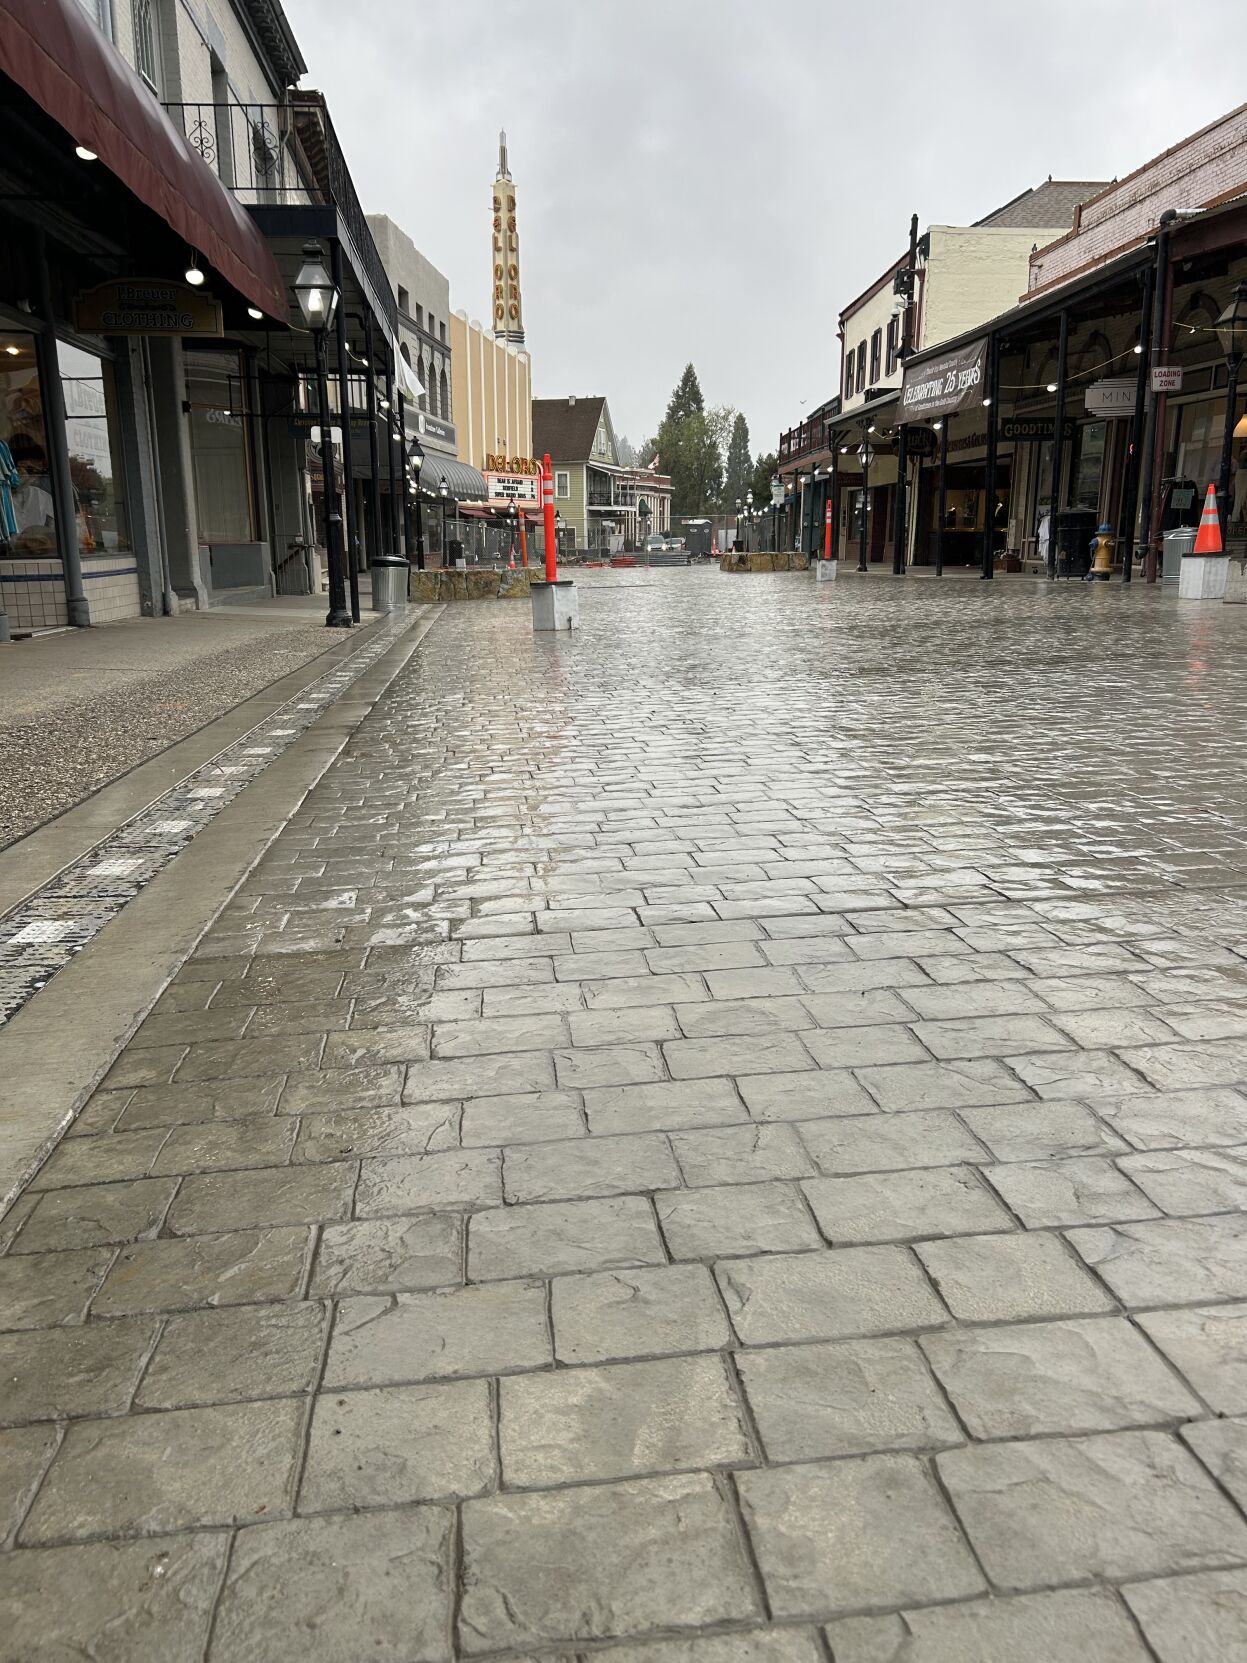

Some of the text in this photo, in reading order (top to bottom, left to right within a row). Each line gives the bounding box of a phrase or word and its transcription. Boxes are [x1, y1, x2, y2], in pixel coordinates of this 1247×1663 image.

[102, 311, 193, 328] CLOTHING
[944, 369, 957, 394] 25
[1154, 370, 1181, 378] LOADING
[1159, 379, 1176, 387] ZONE
[1004, 423, 1072, 438] GOODTIMS
